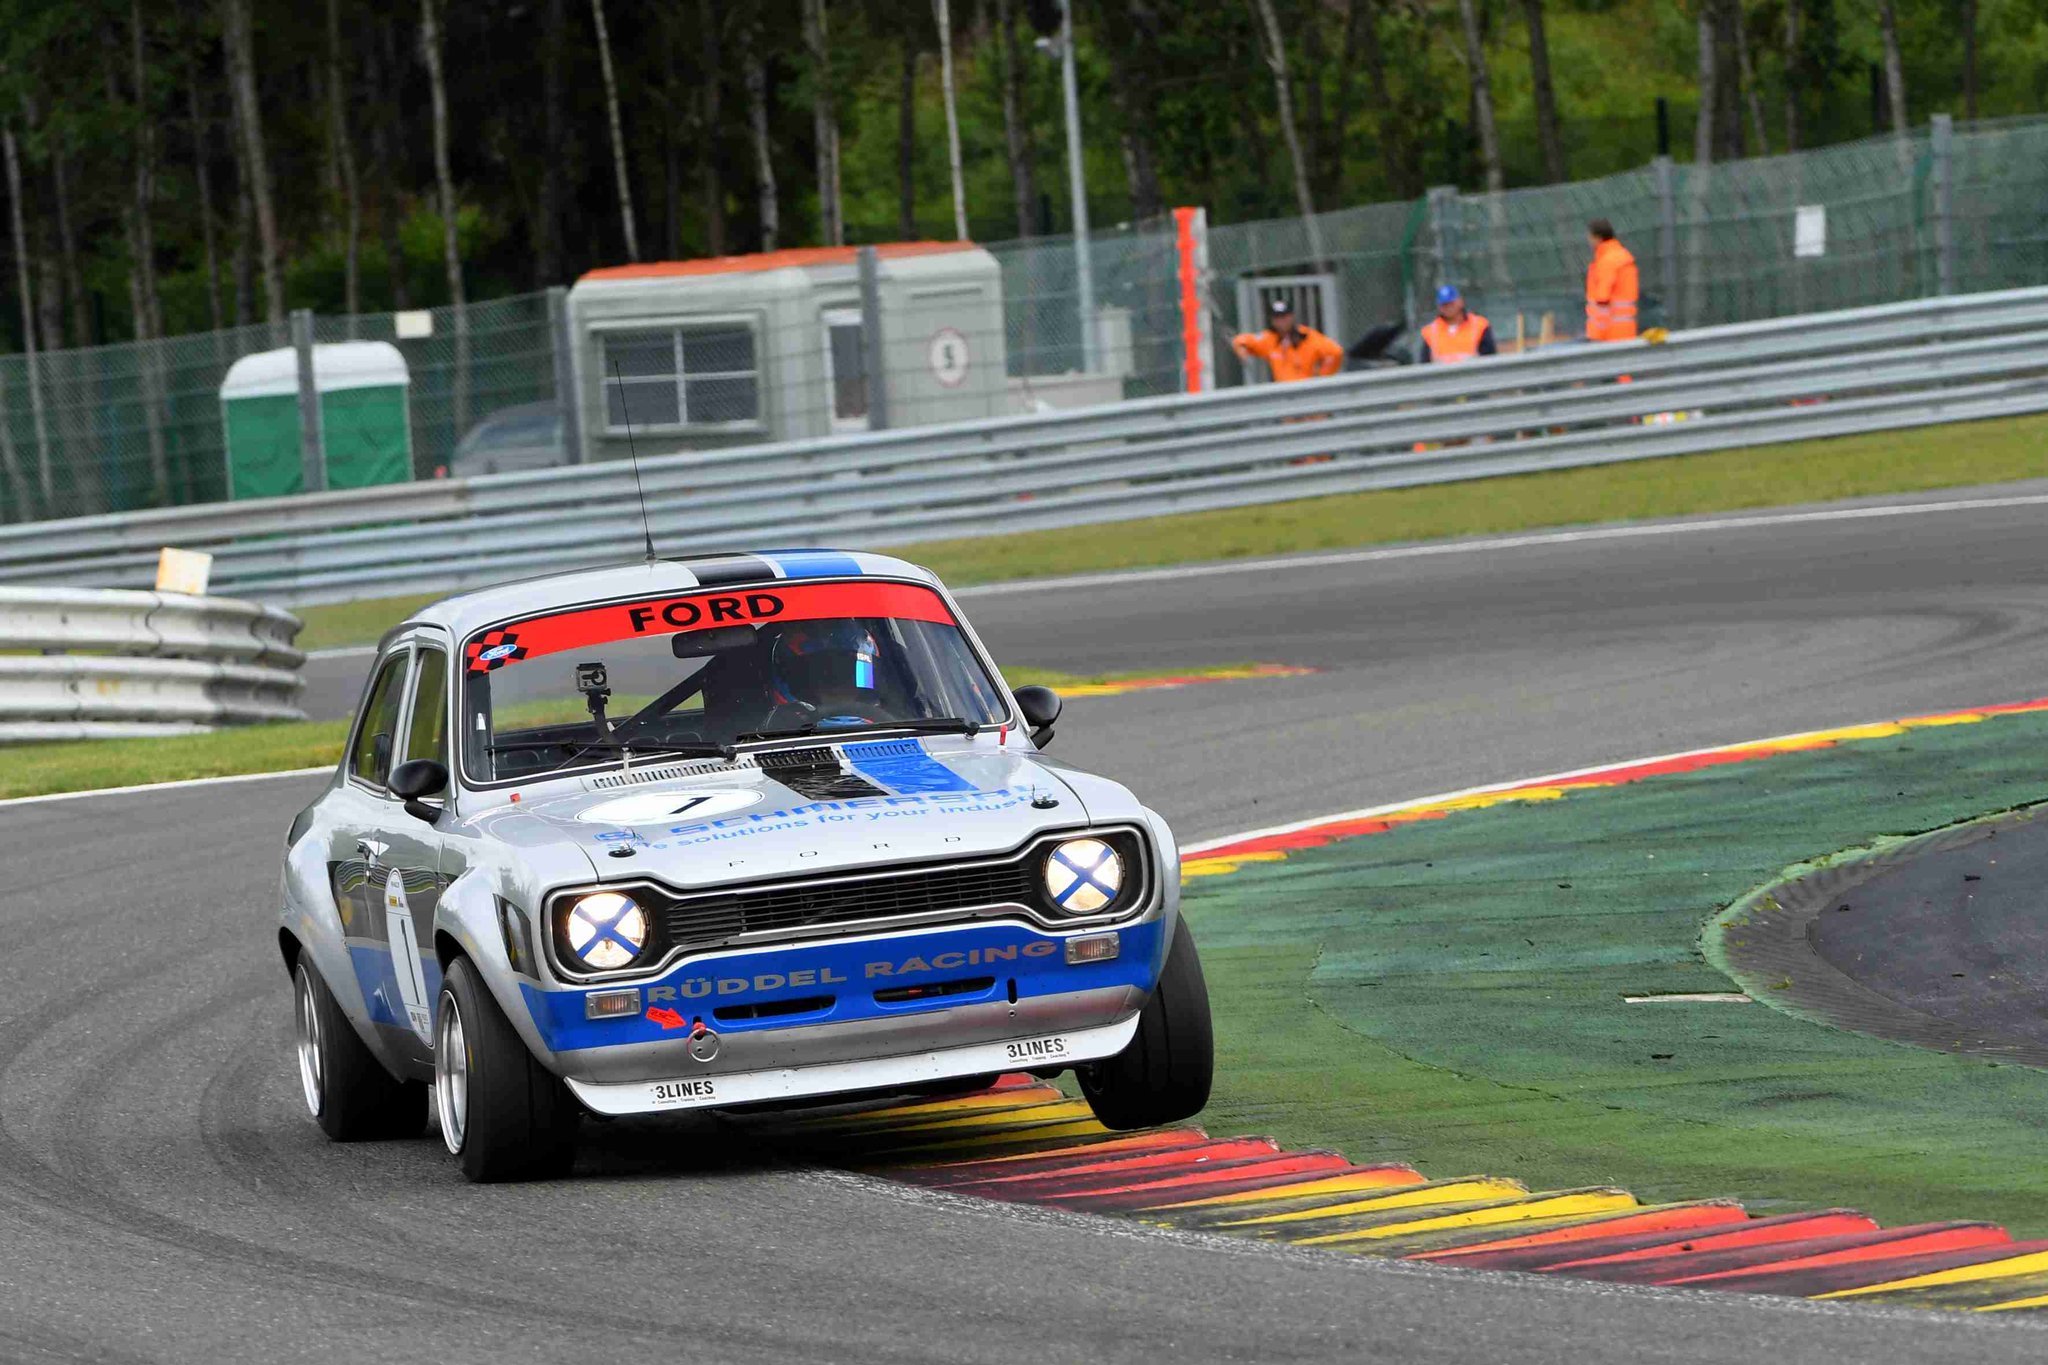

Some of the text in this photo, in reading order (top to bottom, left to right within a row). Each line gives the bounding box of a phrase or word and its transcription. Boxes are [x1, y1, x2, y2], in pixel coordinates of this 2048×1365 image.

[628, 594, 785, 632] FORD
[668, 796, 714, 815] 1
[677, 819, 809, 845] solutions
[818, 811, 857, 824] for
[866, 807, 930, 821] your
[729, 836, 961, 868] FORD
[648, 941, 1057, 1003] RÜDDEL RACING
[1006, 1038, 1064, 1058] 3LINES
[655, 1080, 714, 1099] 3LINES
